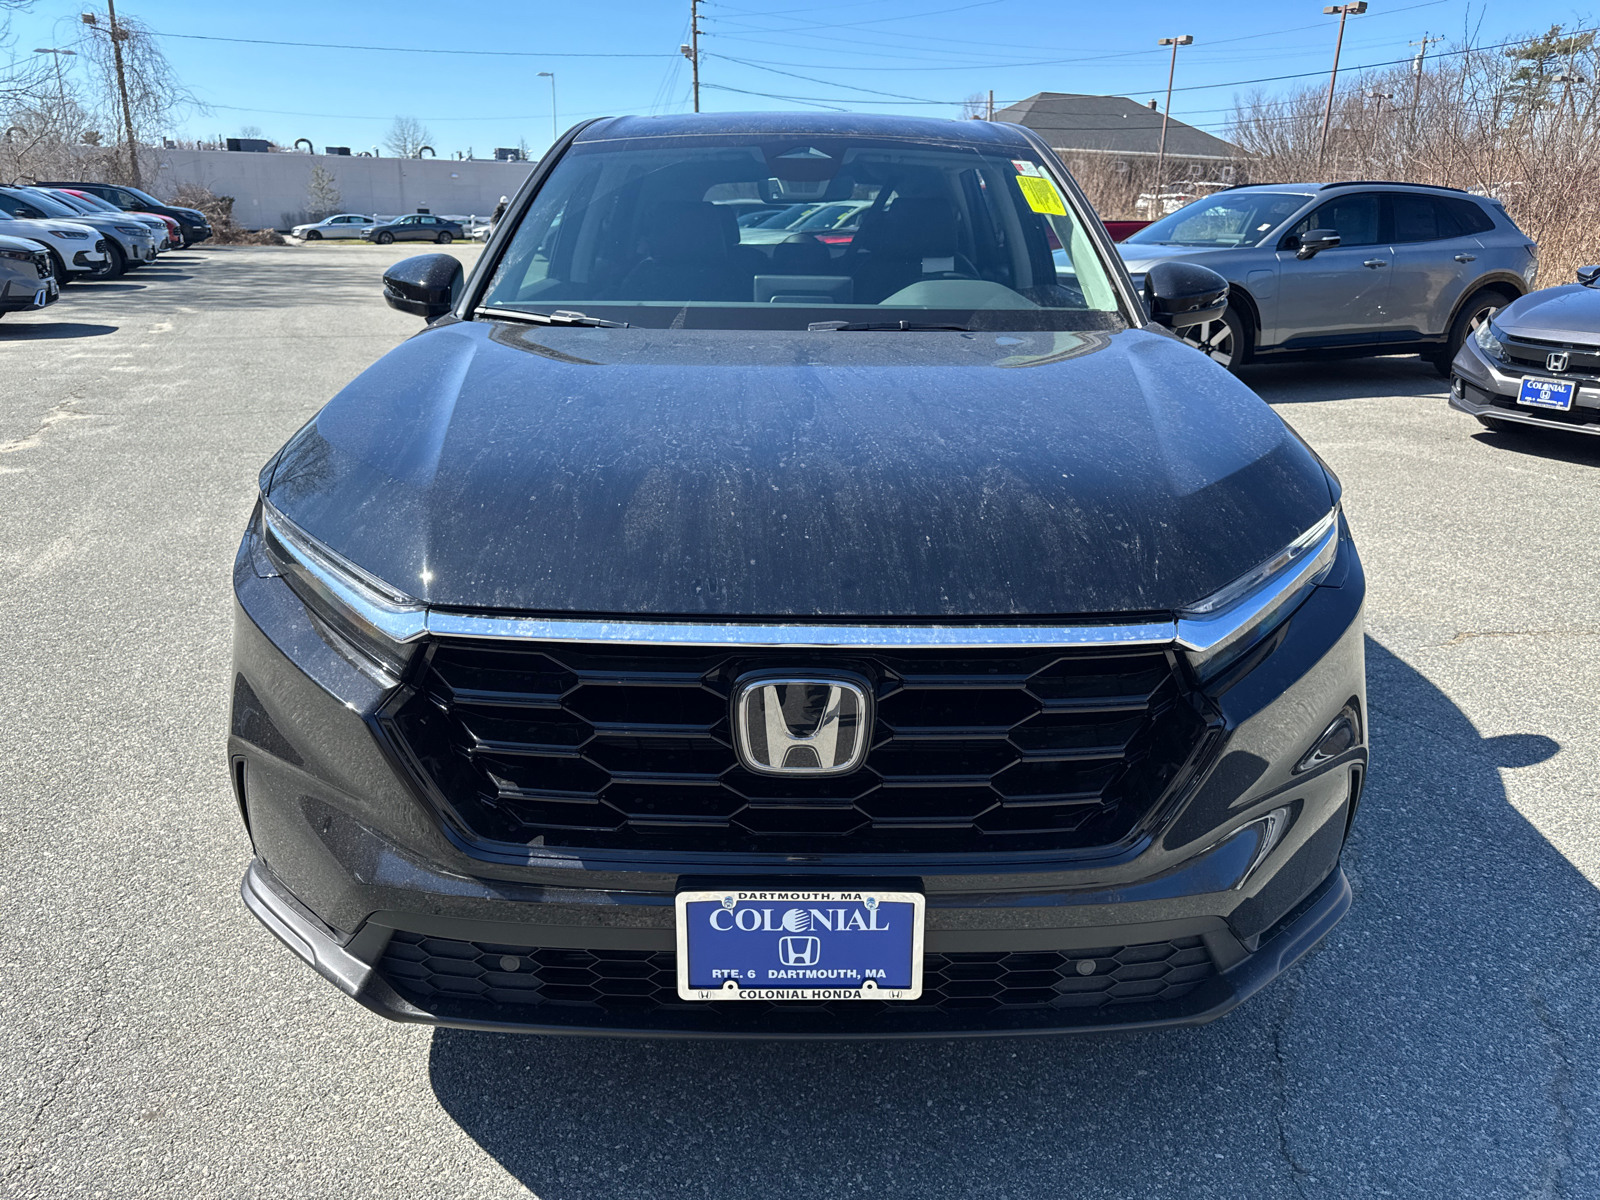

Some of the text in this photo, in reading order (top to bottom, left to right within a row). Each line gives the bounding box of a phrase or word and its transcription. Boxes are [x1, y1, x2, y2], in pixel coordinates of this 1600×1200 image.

[1527, 381, 1567, 393] COLONIAL
[738, 892, 862, 901] DARTMOUTH, MA
[709, 908, 890, 933] COLONIAL
[712, 969, 886, 980] RTE. 6 DARTMOUTH, MA
[739, 990, 862, 999] COLONIAL HONDA
